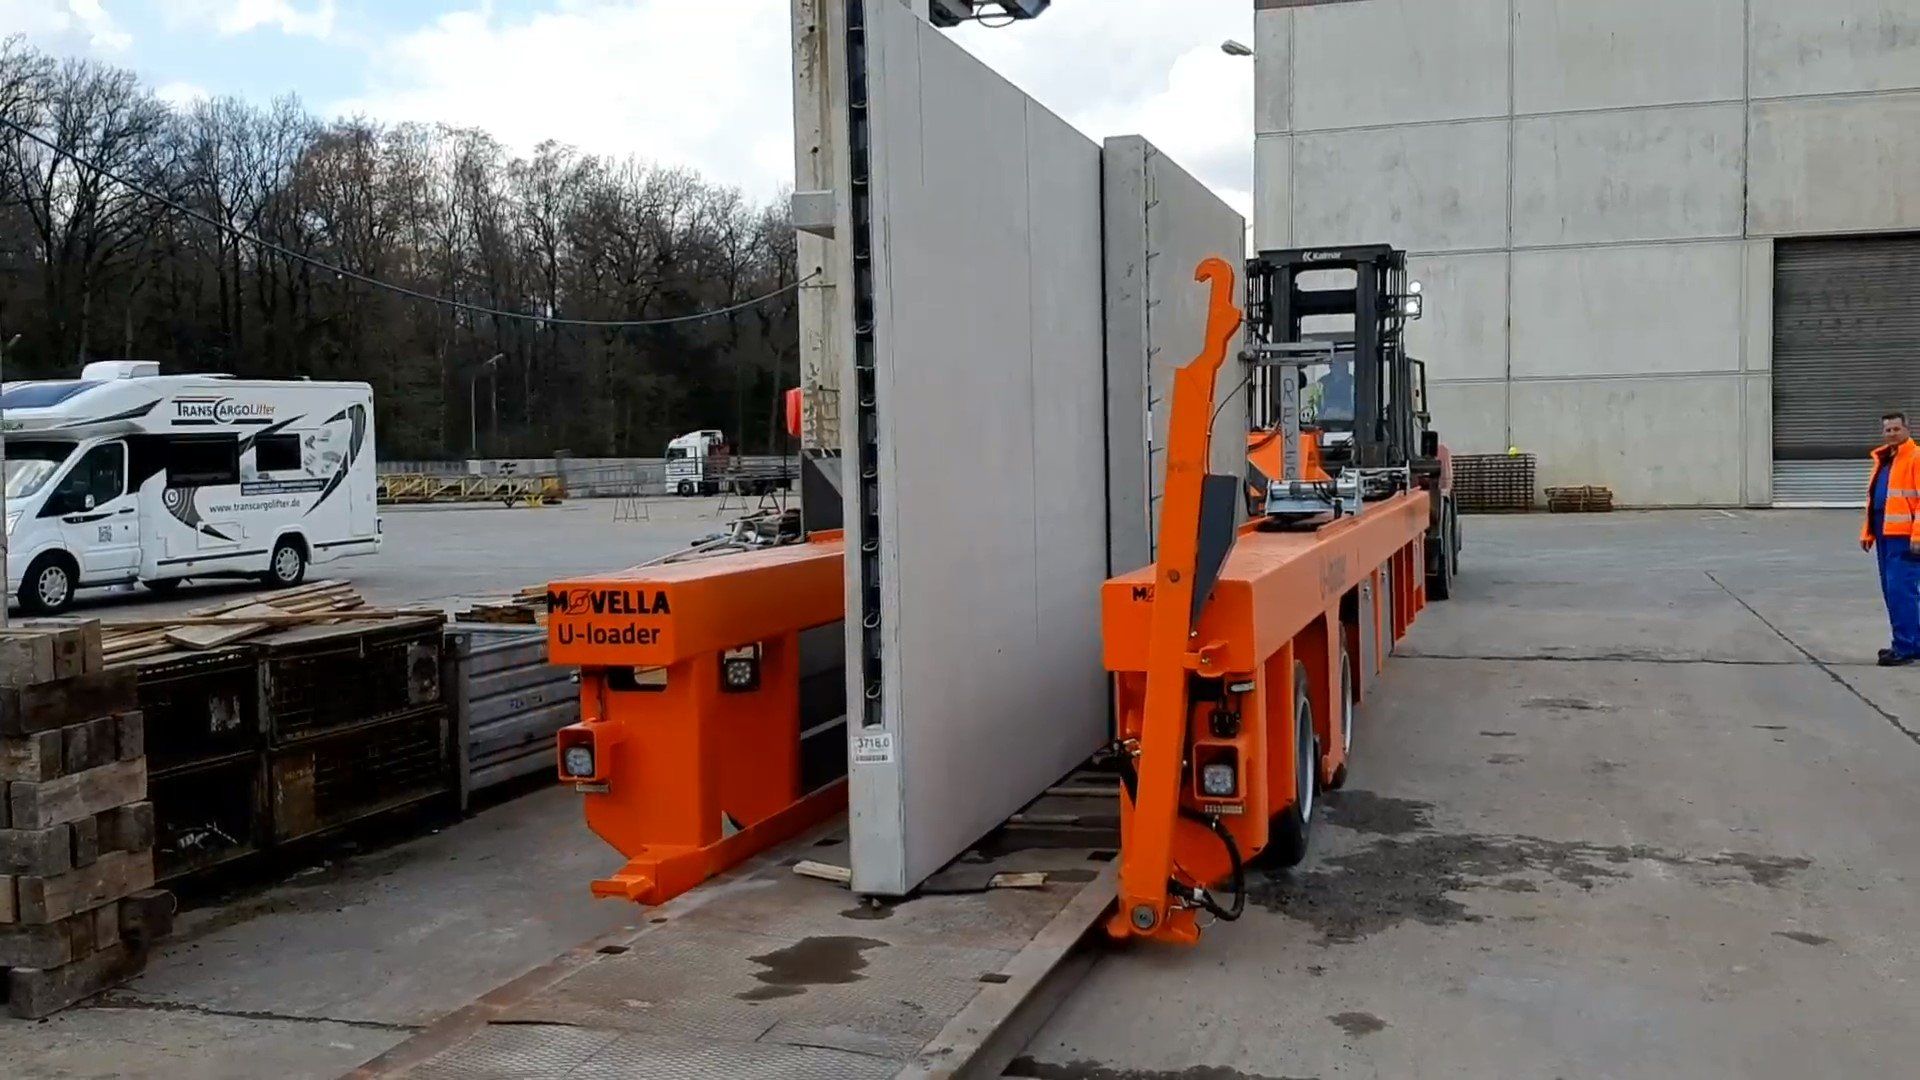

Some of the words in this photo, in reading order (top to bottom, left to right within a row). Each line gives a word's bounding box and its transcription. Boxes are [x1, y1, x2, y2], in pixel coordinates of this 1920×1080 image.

[209, 498, 301, 513] www.transcargolifter.de
[547, 588, 671, 615] MOVELLA
[558, 622, 661, 644] U-loader
